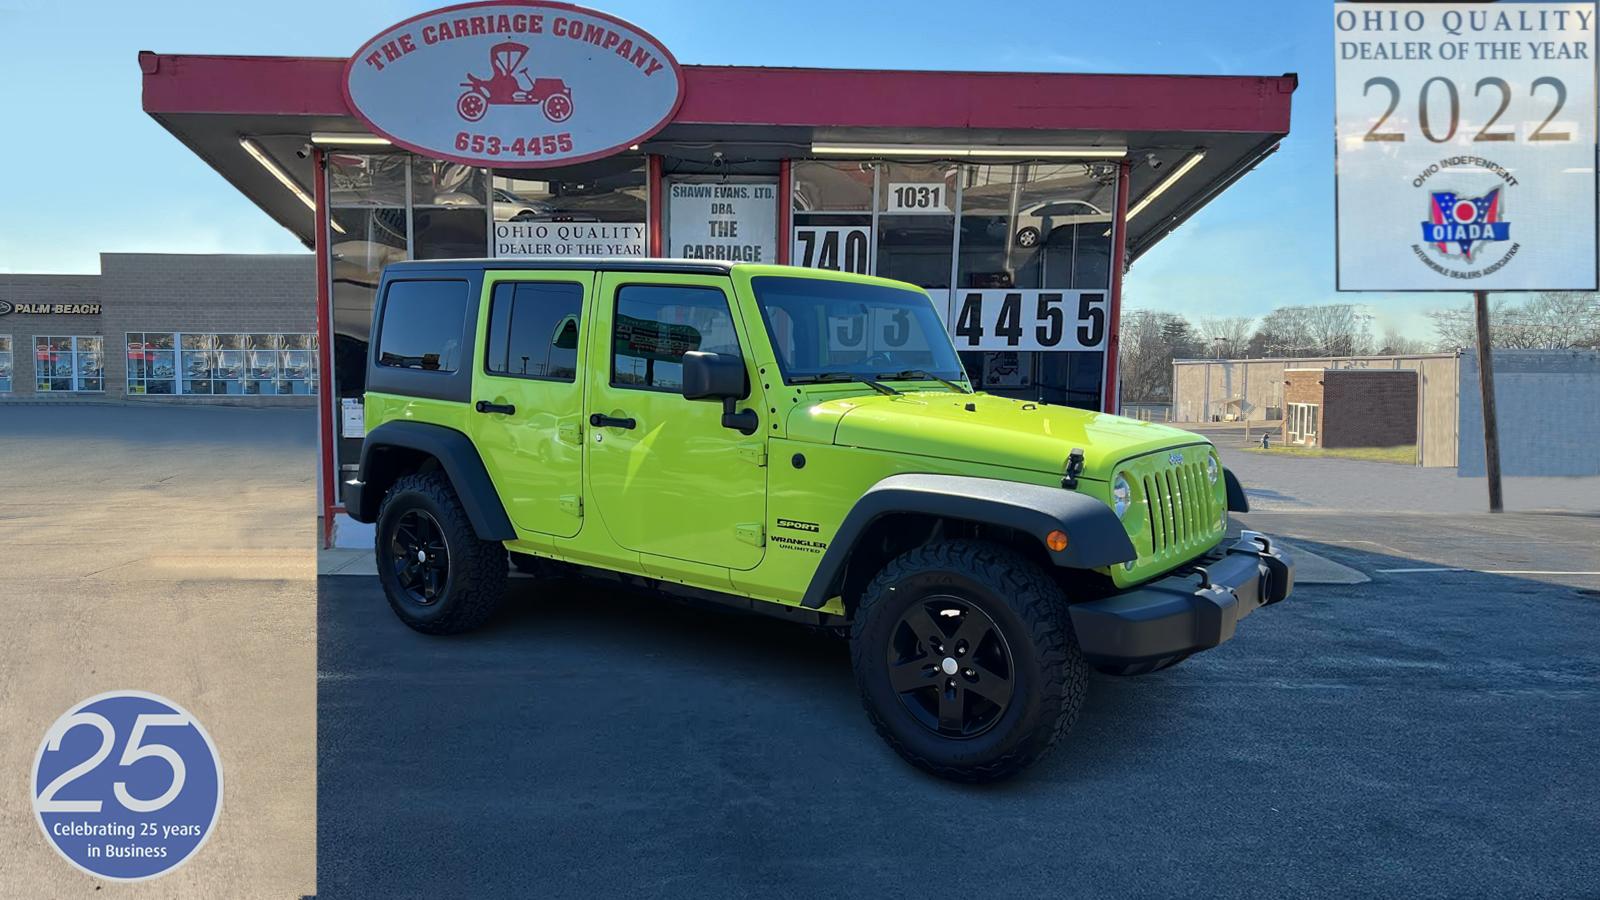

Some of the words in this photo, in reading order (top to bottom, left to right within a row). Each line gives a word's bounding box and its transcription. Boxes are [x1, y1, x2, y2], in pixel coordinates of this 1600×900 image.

[1336, 10, 1425, 32] OHIO
[1442, 10, 1593, 35] QUALITY
[366, 34, 416, 72] THE
[423, 14, 544, 46] CARRIAGE
[553, 16, 664, 78] COMPANY
[1340, 42, 1432, 60] DEALER
[1439, 42, 1469, 60] OF
[1475, 42, 1522, 60] THE
[1528, 42, 1588, 60] YEAR
[1363, 76, 1571, 143] 2022
[455, 132, 573, 157] 653-4455
[1413, 163, 1440, 188] OHIO
[1440, 155, 1519, 187] INDEPENDENT
[672, 186, 712, 199] SHAWN
[754, 186, 775, 199] LTD.
[894, 186, 940, 208] 1031
[711, 202, 736, 215] DBA.
[497, 225, 549, 240] OHIO
[558, 225, 644, 241] QUALITY
[708, 220, 738, 238] THE
[1433, 224, 1495, 240] OIADA
[499, 243, 551, 256] DEALER
[556, 243, 574, 256] OF
[575, 243, 604, 256] THE
[607, 243, 642, 256] YEAR
[682, 244, 762, 262] CARRIAGE
[797, 229, 869, 275] 740
[1450, 269, 1482, 280] DEALERS
[14, 303, 51, 314] PALM
[54, 303, 100, 314] BEACH
[956, 293, 1105, 347] 4455
[779, 520, 817, 531] SPORT
[770, 535, 827, 549] WRANGLER
[779, 544, 821, 554] UNLIMITED
